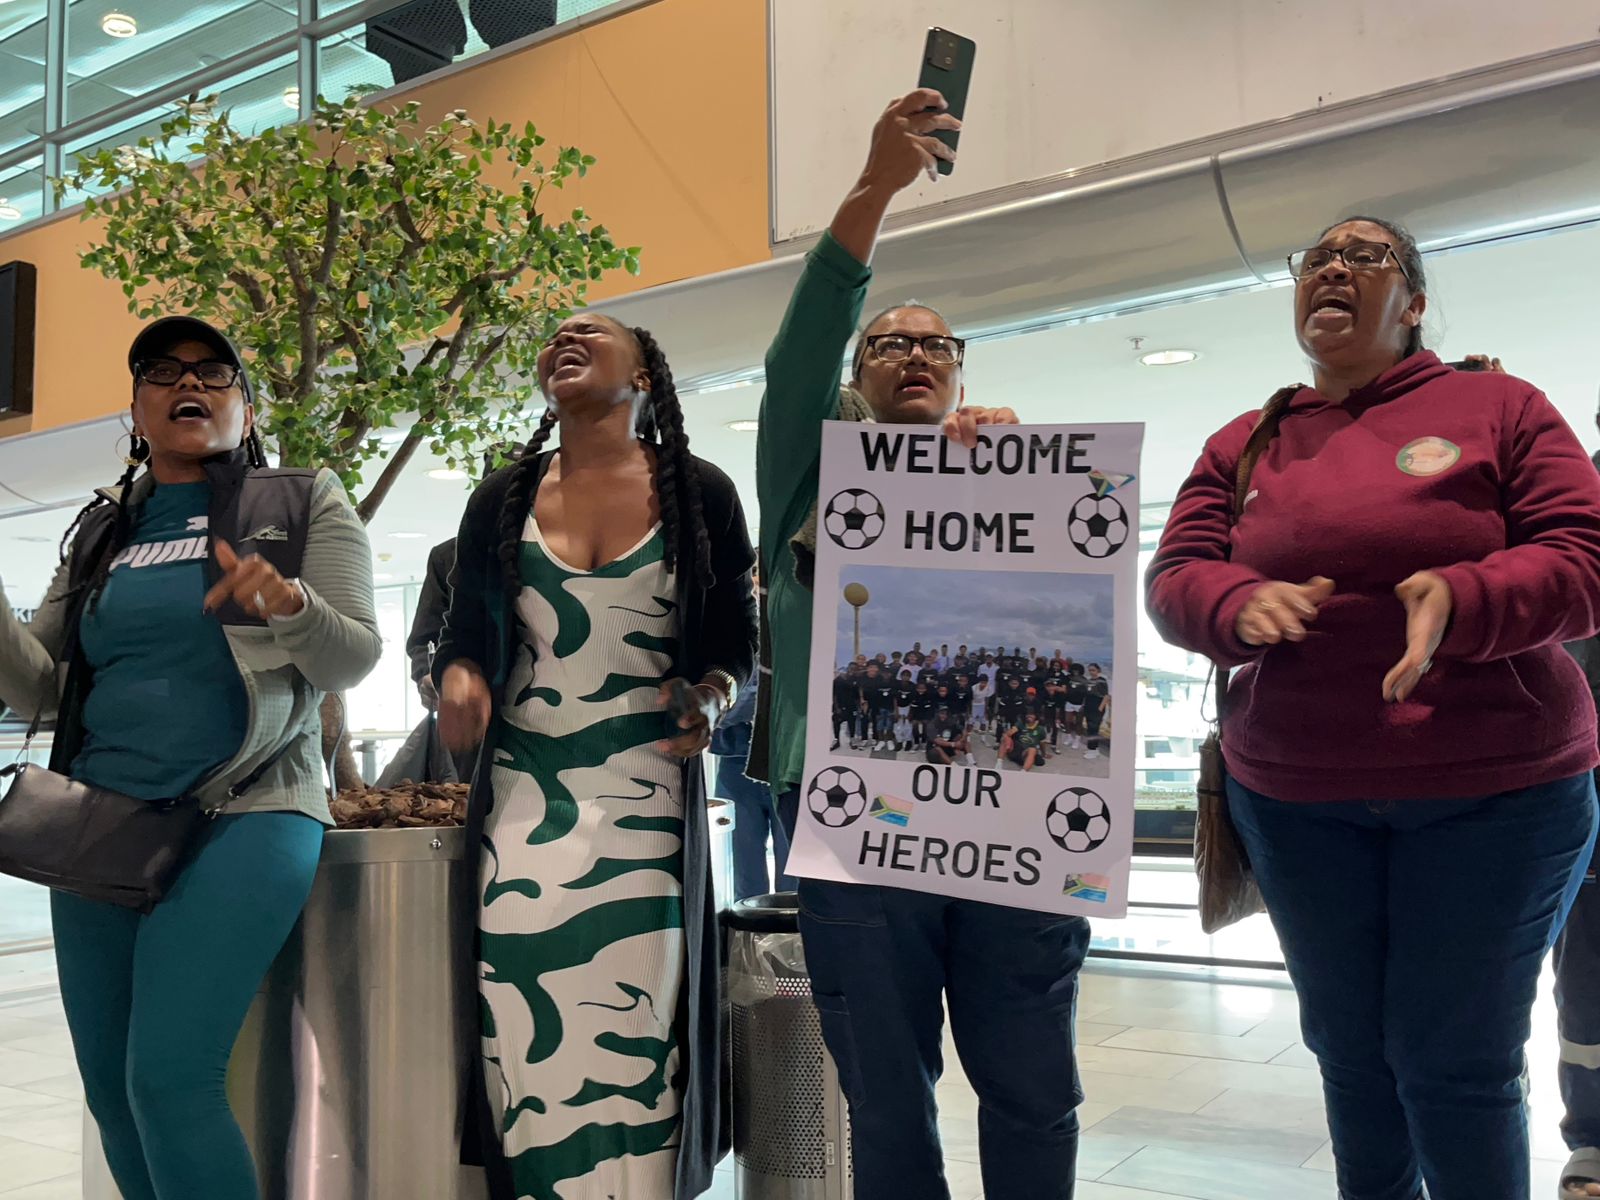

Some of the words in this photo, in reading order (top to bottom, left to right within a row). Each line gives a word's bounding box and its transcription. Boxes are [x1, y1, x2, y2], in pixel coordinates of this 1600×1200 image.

[860, 431, 1096, 475] WELCOME
[903, 510, 1036, 554] HOME
[911, 764, 1003, 809] OUR
[857, 830, 1042, 886] HEROES
